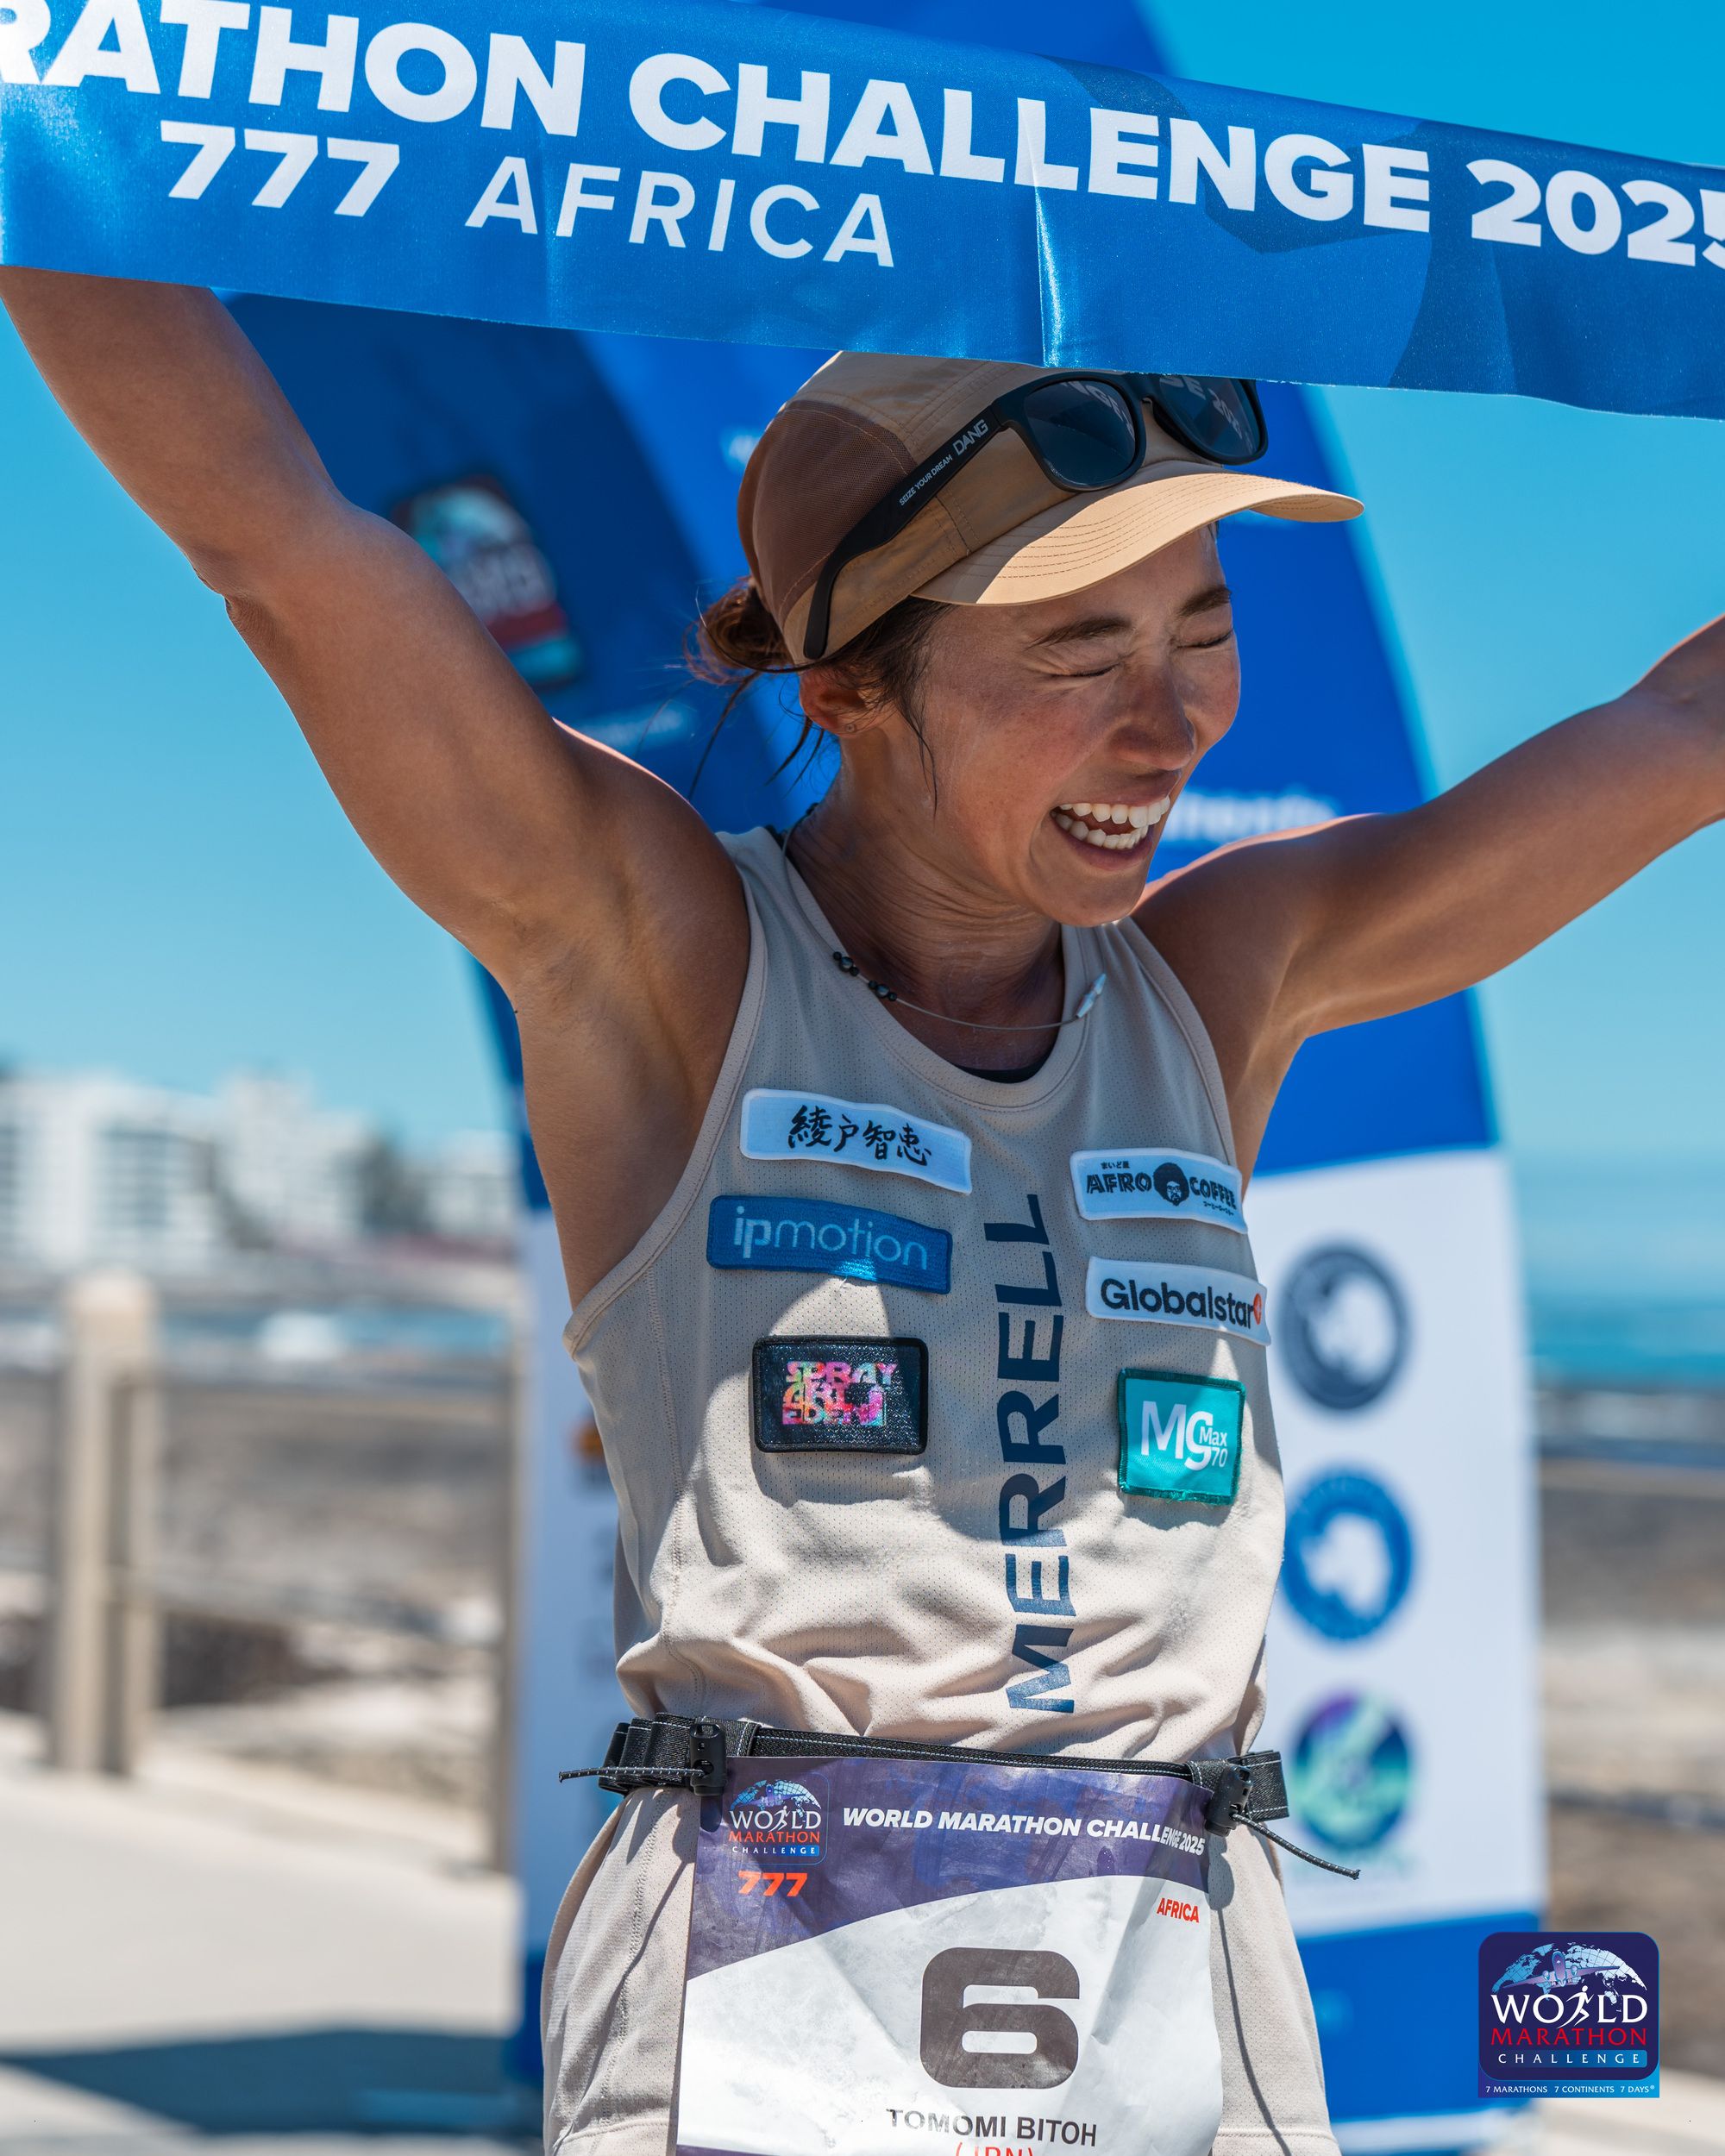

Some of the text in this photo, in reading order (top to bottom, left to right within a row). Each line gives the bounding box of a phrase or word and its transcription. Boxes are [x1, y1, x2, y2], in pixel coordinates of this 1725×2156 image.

[629, 53, 1430, 233] CHALLENGE
[160, 120, 894, 267] 777 AFRICA
[899, 419, 988, 506] SEIZE YOUR DREAM DANG
[1086, 1172, 1152, 1194] AFRO
[1189, 1176, 1237, 1210] COFFEE
[733, 1206, 927, 1270] ipmotion
[1101, 1278, 1253, 1329] Globalstar
[983, 1194, 1076, 1714] MERRELL
[1199, 1426, 1227, 1447] Max
[1210, 1447, 1228, 1468] 70
[728, 1830, 820, 1844] MARATHON
[731, 1846, 817, 1855] CHALLENGE
[843, 1808, 1206, 1856] WORLD MARATHON CHALLENGE 2025
[737, 1870, 808, 1897] 777
[1156, 1897, 1200, 1923] AFRICA
[919, 1946, 1080, 2090] 6
[886, 2109, 1097, 2147] TOMOMI BITOH
